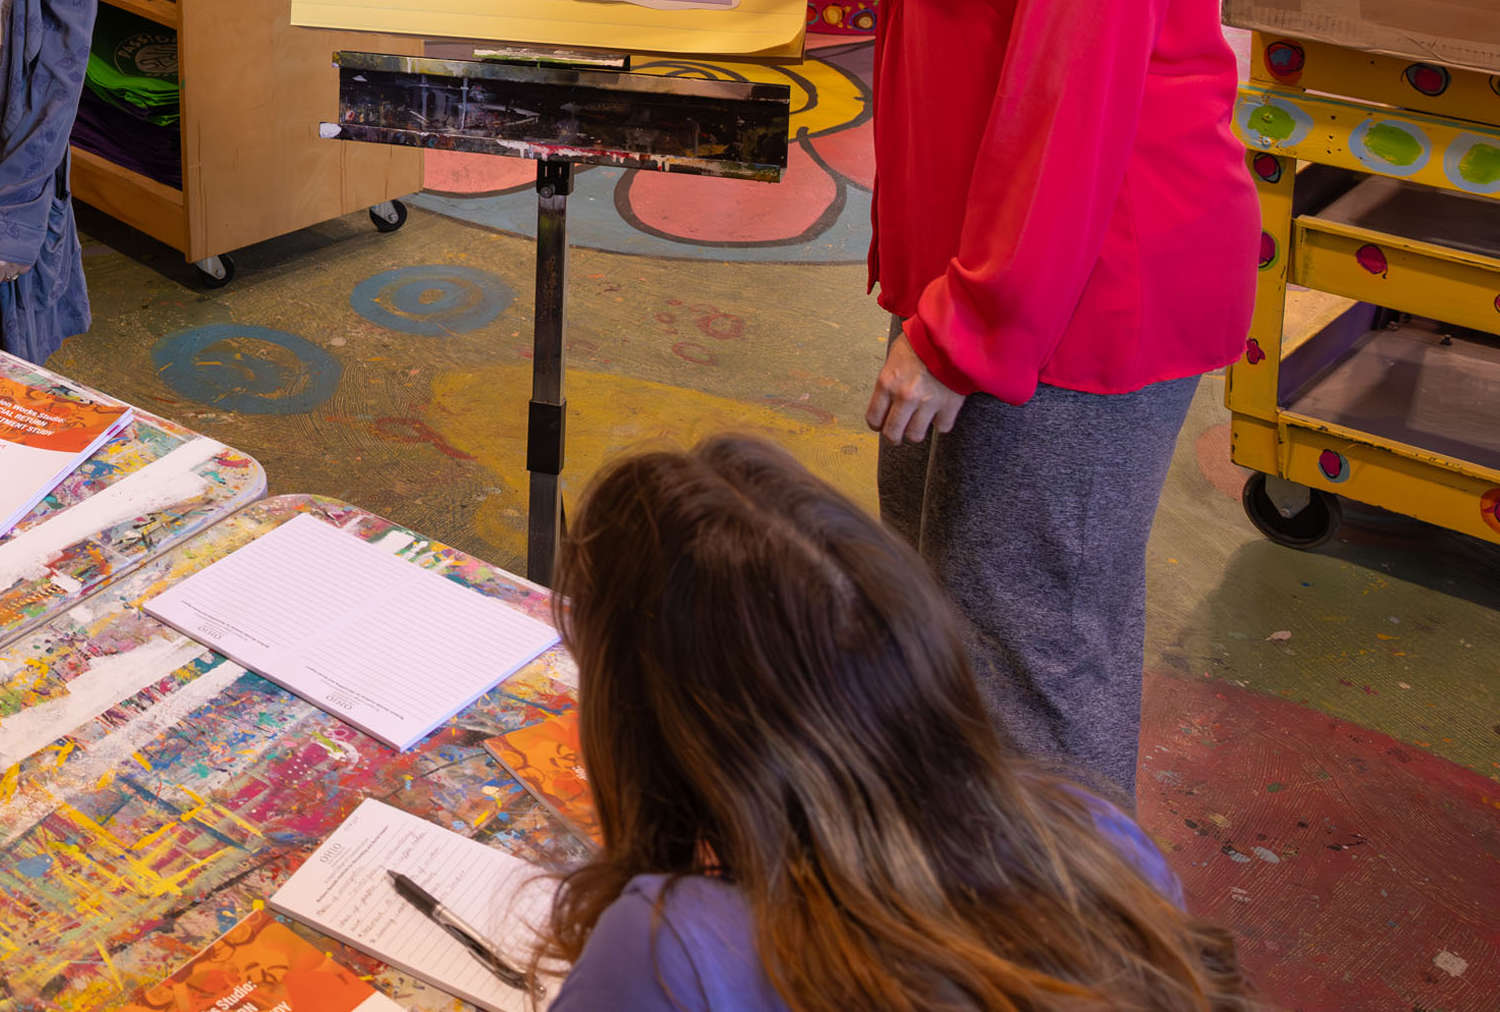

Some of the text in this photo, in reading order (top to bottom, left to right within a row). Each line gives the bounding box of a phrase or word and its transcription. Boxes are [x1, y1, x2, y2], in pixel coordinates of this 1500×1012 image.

[12, 404, 37, 415] Works
[37, 412, 65, 422] Studio:
[14, 413, 47, 426] RETURN
[26, 426, 53, 435] STUDY
[197, 625, 222, 640] OHIO
[325, 693, 354, 711] OHIO
[318, 842, 343, 864] OHIO
[218, 980, 257, 1010] Studio:
